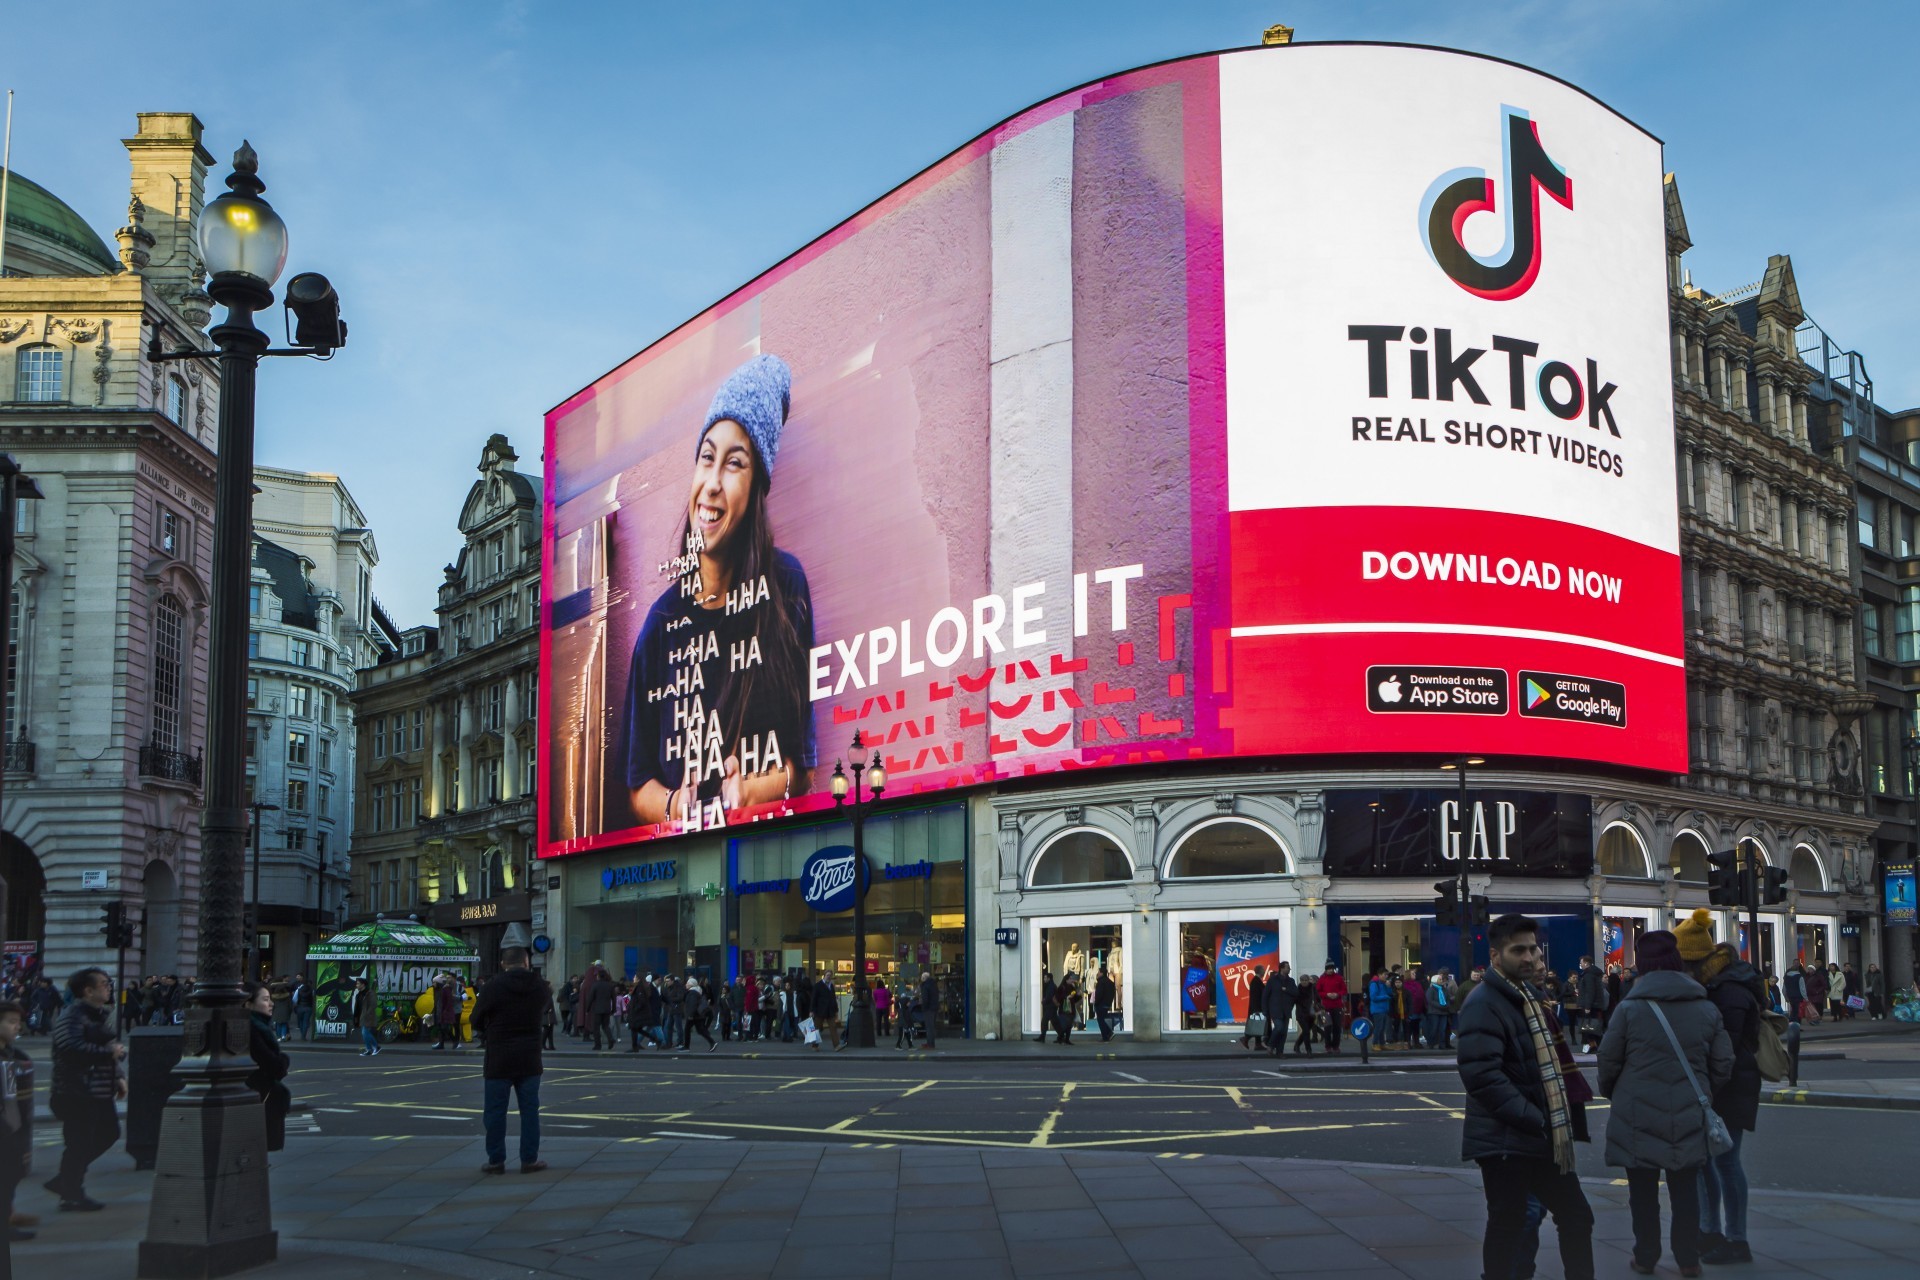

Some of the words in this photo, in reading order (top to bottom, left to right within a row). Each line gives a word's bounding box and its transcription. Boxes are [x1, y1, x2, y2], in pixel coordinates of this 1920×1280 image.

[1348, 325, 1622, 439] TikTok
[1352, 416, 1435, 443] REAL
[1444, 420, 1542, 455] SHORT
[1547, 433, 1624, 478] VIDEOS
[140, 462, 169, 490] ALLIANCE
[174, 485, 186, 502] LIFE
[191, 497, 210, 517] OFFICE
[681, 571, 703, 599] HA
[1362, 551, 1561, 591] DOWNLOAD
[1568, 566, 1623, 604] NOW
[666, 616, 692, 632] HA
[809, 581, 1046, 702] EXPLORE
[1073, 563, 1144, 638] IT
[668, 644, 697, 665] HA
[690, 630, 720, 665] HA
[730, 636, 762, 673] HA
[675, 662, 705, 697] HA
[1410, 675, 1460, 685] Download
[1462, 677, 1475, 686] on
[1477, 677, 1494, 687] the
[1556, 681, 1571, 690] GET
[1571, 682, 1579, 692] IT
[1578, 683, 1590, 693] ON
[648, 684, 679, 703] HA
[1409, 686, 1449, 707] App
[1452, 687, 1499, 705] Store
[674, 694, 706, 731] HA
[1556, 693, 1600, 717] Google
[1600, 698, 1622, 721] Play
[685, 737, 726, 786] HA
[741, 730, 783, 777] HA
[1440, 800, 1516, 861] GAP
[615, 861, 677, 886] BARCLAYS
[806, 855, 857, 901] Boots
[885, 859, 934, 879] beauty
[735, 880, 790, 896] pharmacy
[461, 905, 481, 920] JEWEL
[482, 903, 498, 918] BAR
[997, 932, 1007, 940] GAP
[1226, 937, 1251, 951] GAP
[1230, 929, 1267, 944] GREAT
[1223, 946, 1253, 960] SALE
[1223, 967, 1236, 977] UP
[1236, 964, 1249, 974] TO
[316, 1020, 348, 1034] WICKED
